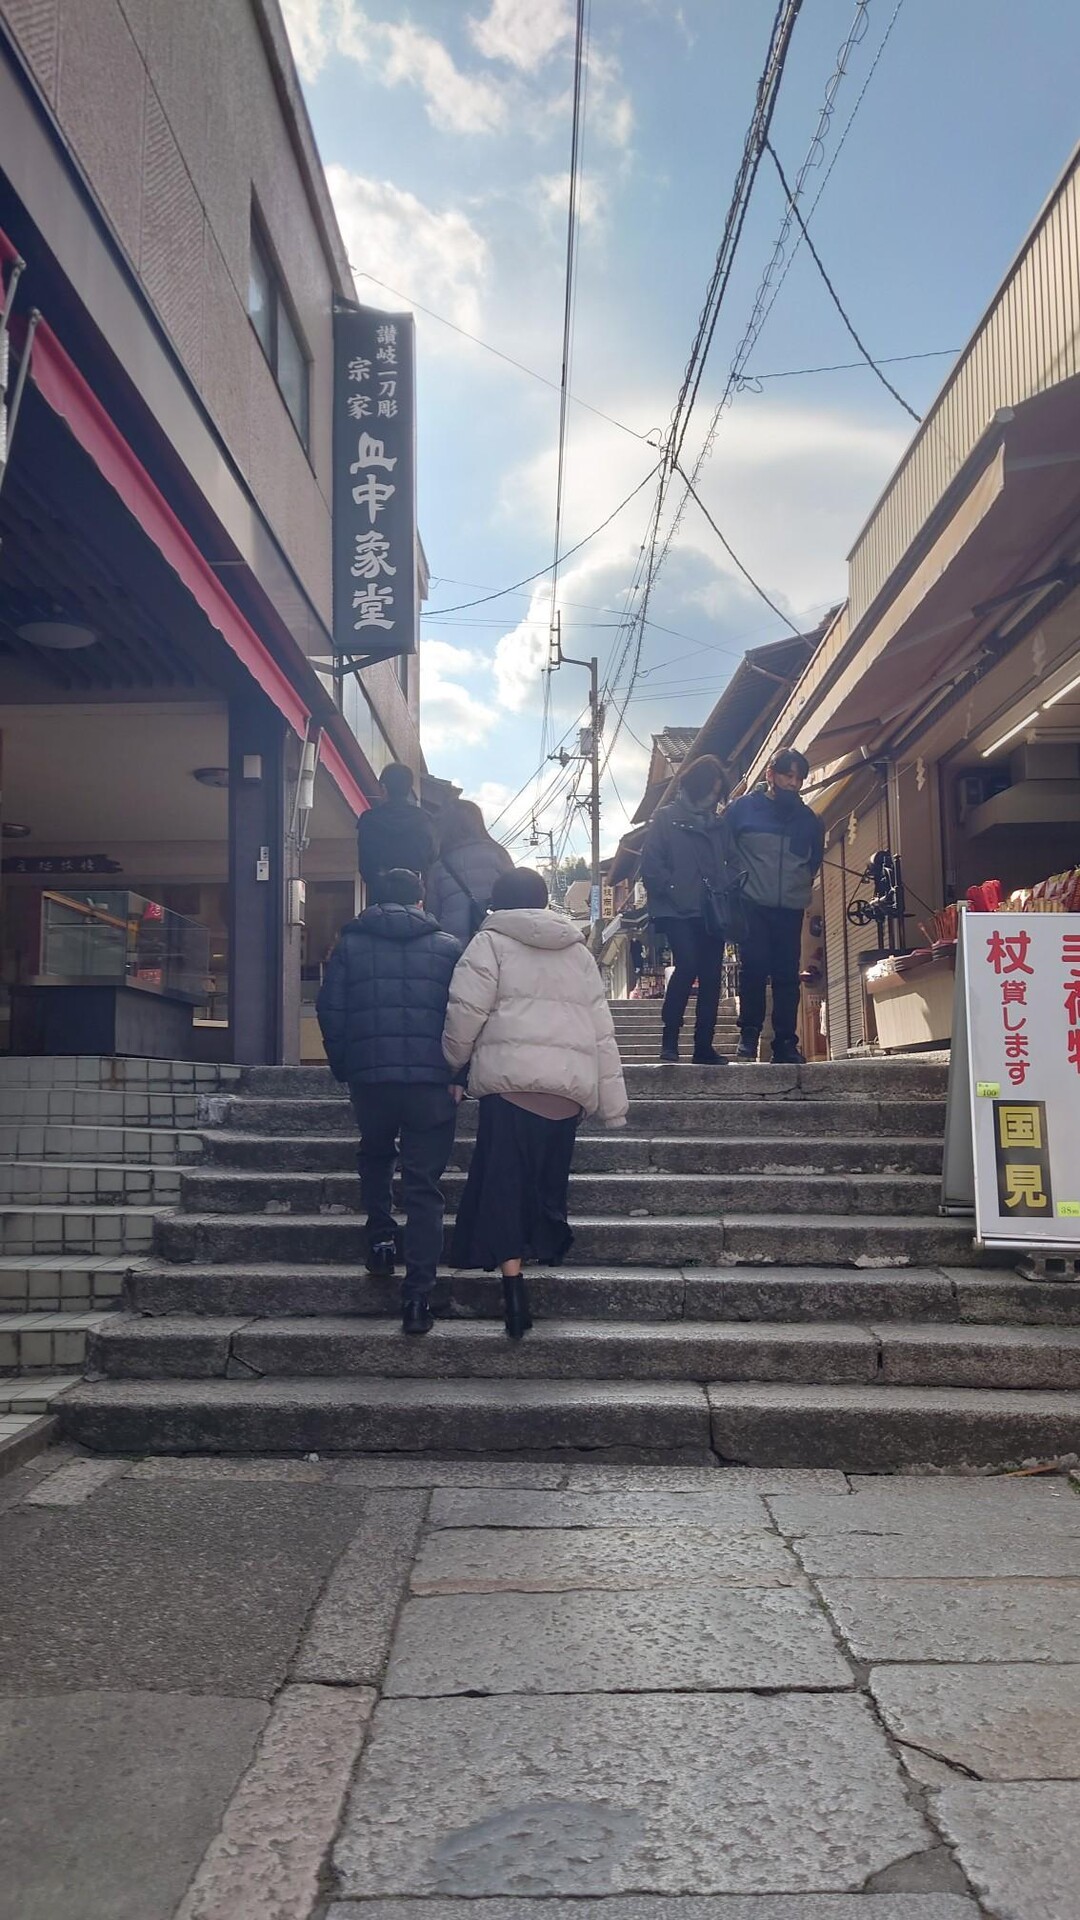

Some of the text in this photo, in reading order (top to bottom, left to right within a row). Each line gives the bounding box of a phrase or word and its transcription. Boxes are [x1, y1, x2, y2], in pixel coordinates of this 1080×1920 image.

[347, 356, 373, 420] 宗家
[986, 930, 1034, 1086] 杖貸します
[998, 1106, 1047, 1208] 国見
